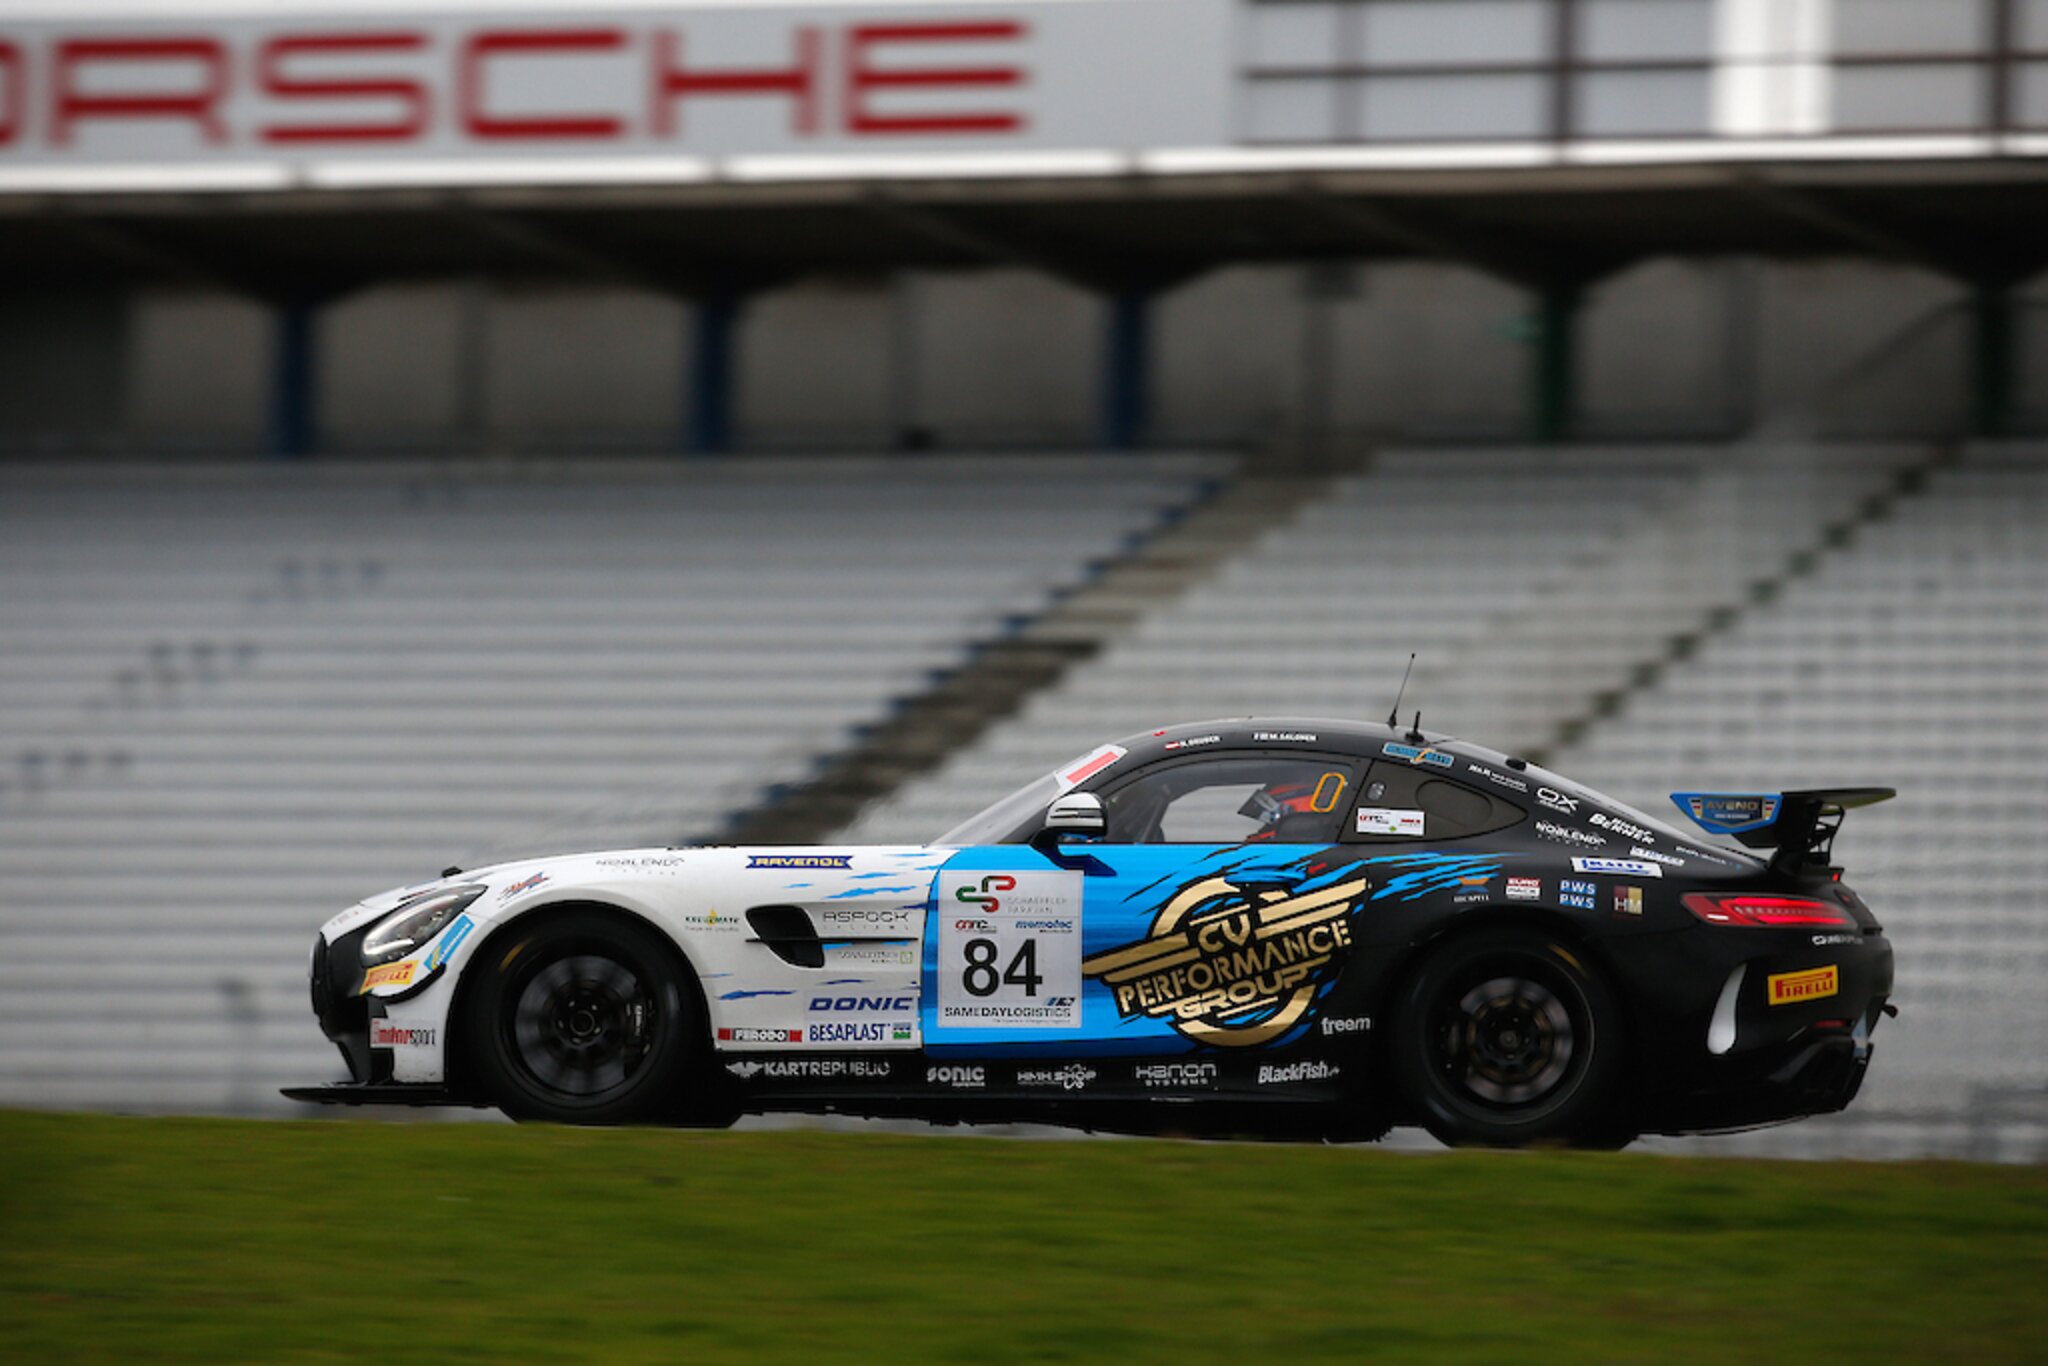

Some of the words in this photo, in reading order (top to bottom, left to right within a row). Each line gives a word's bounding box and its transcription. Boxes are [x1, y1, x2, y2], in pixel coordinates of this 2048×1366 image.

[0, 20, 1028, 148] RSCHE
[1537, 787, 1579, 811] OX
[1706, 801, 1759, 810] AVENO
[755, 857, 844, 867] RAVENOL
[1560, 880, 1596, 895] PWS
[1559, 894, 1595, 909] PWS
[1199, 913, 1251, 954] CV
[962, 937, 1043, 997] 84
[1117, 919, 1352, 1014] PERFORMANCE
[1172, 960, 1314, 1019] GROUP
[1774, 970, 1834, 999] PIRELLI
[808, 997, 913, 1011] DONIC
[734, 1029, 786, 1042] FERODO
[809, 1023, 886, 1042] BESAPLAST
[1321, 1015, 1371, 1036] freem
[764, 1061, 890, 1076] KARTREPUBLIC
[1017, 1071, 1052, 1082] HMH
[1053, 1071, 1097, 1083] SHOP
[1257, 1060, 1328, 1084] BlackFish
